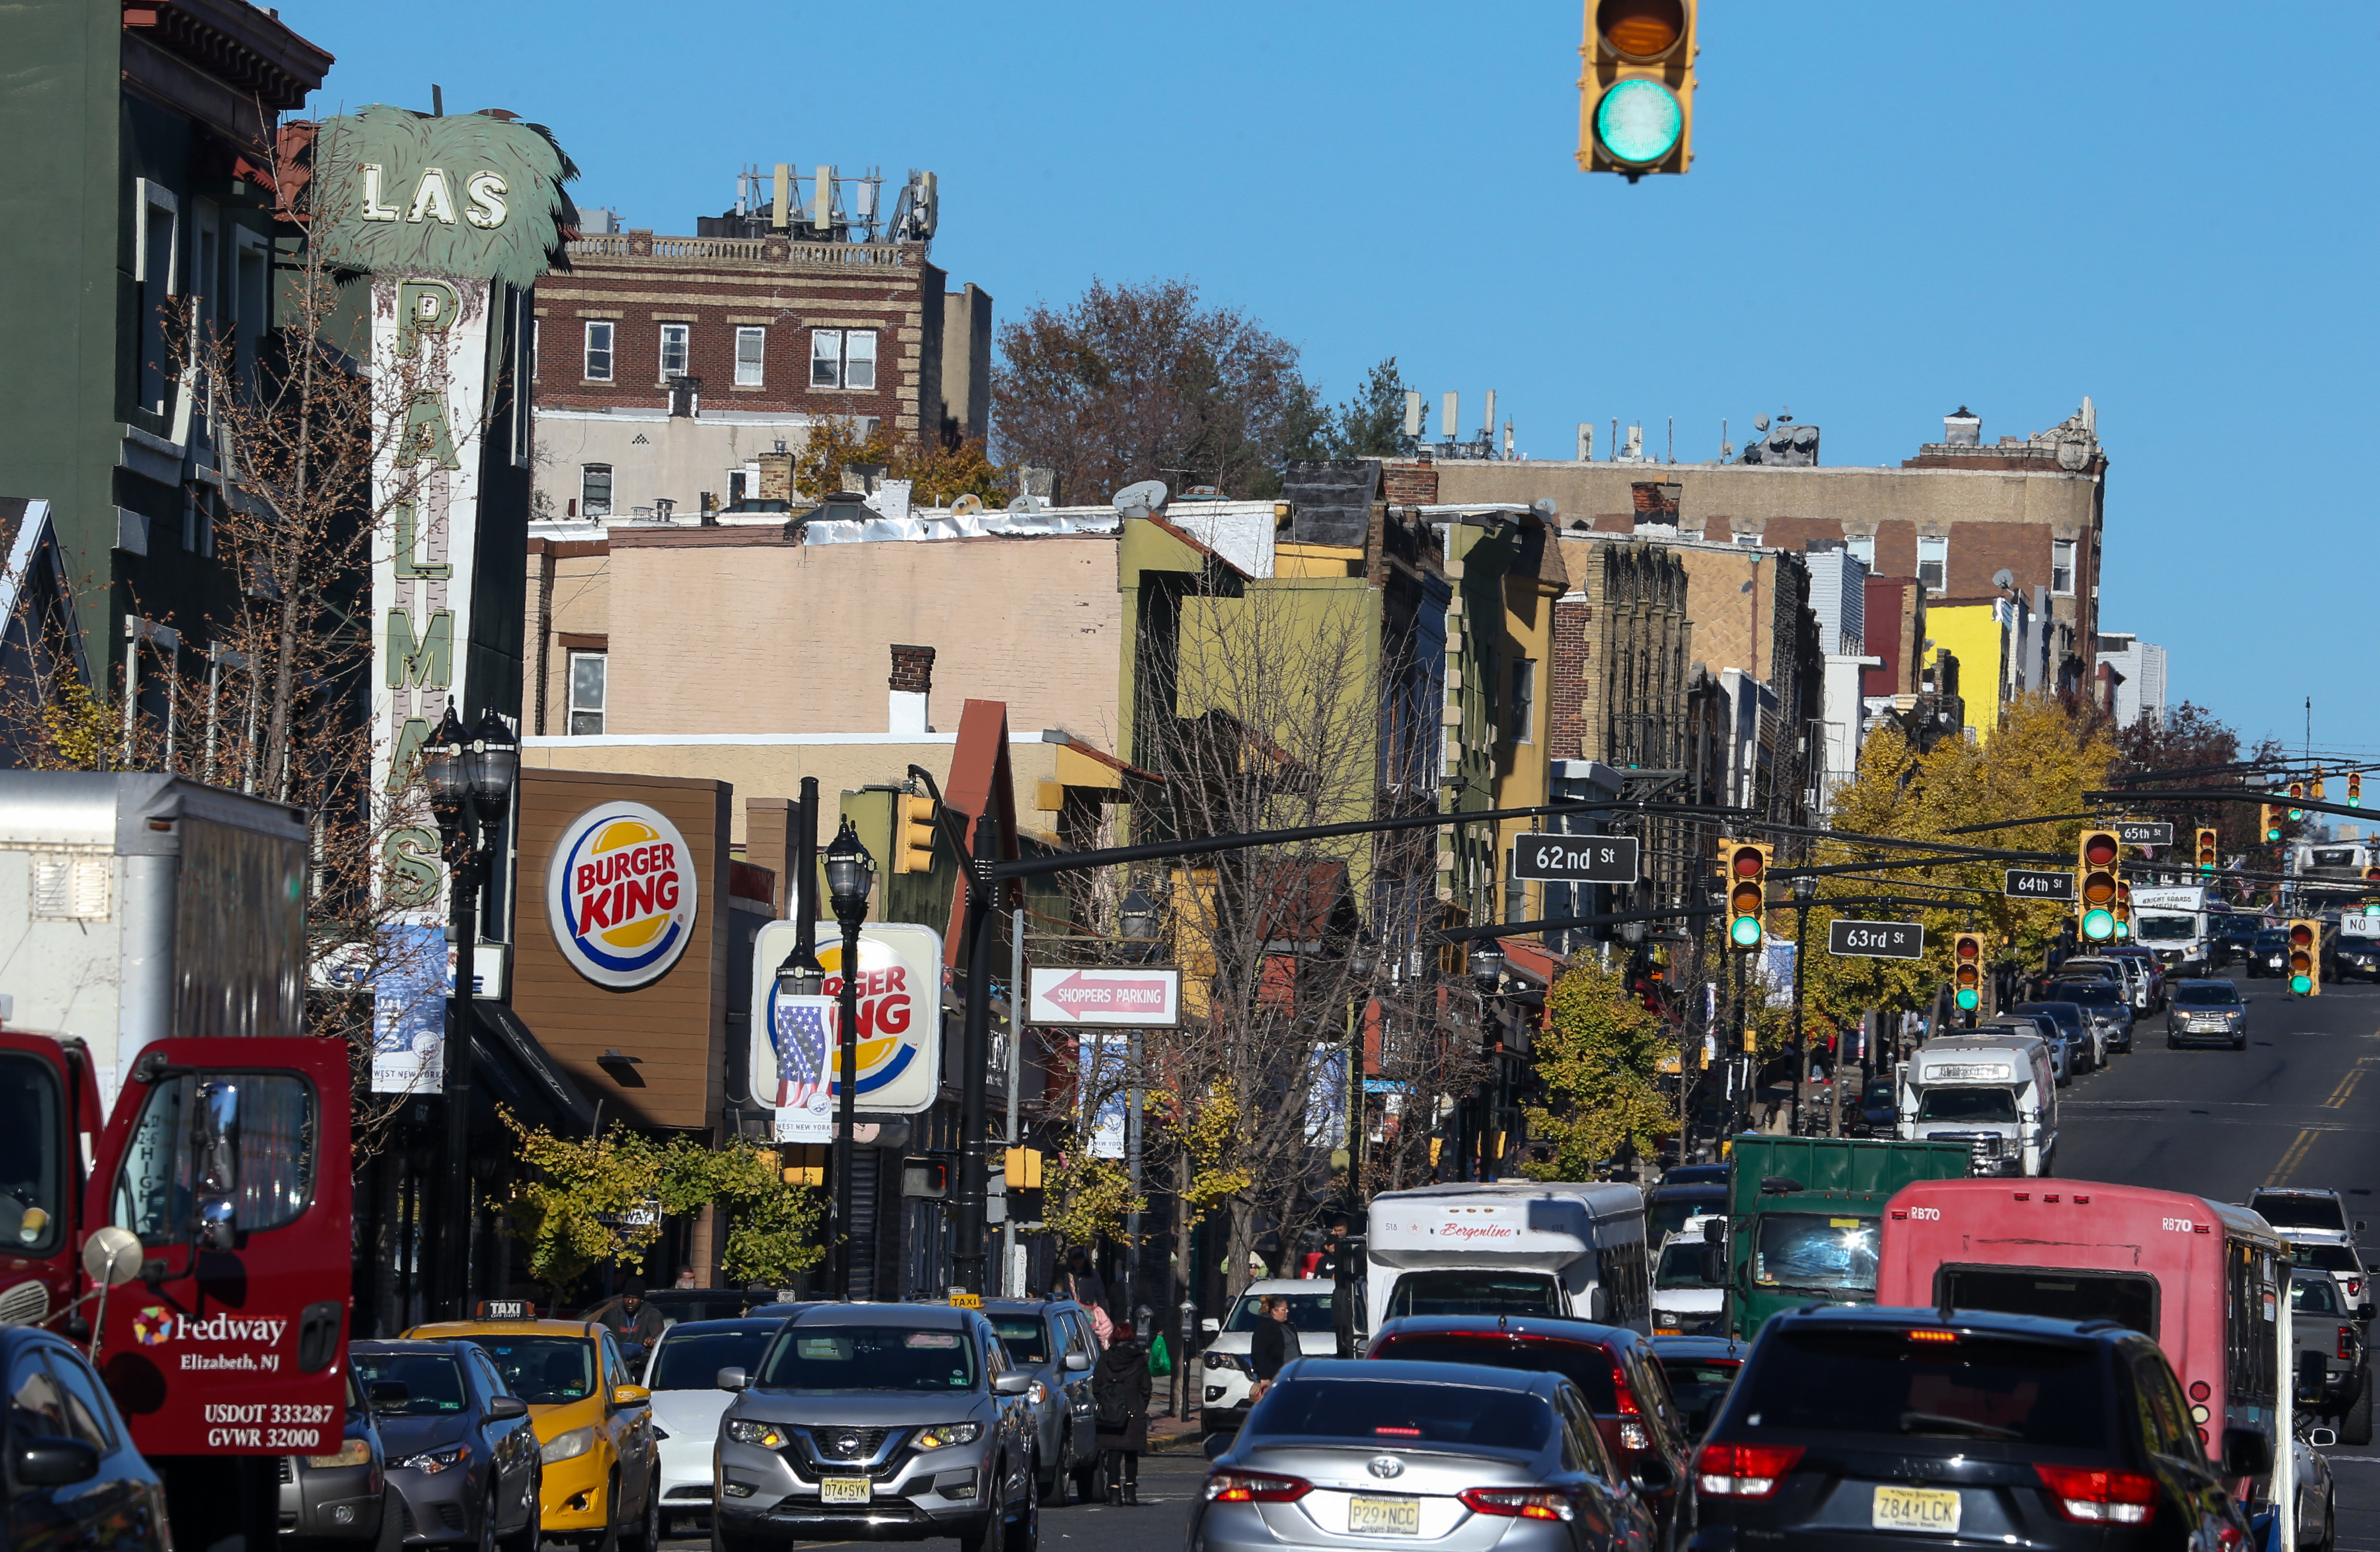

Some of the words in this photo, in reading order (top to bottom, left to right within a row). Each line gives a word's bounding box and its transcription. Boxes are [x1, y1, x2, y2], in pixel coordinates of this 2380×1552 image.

[362, 164, 508, 229] LAS
[382, 279, 460, 906] PALMAS
[2124, 828, 2150, 840] 65th
[2153, 828, 2161, 836] St
[1536, 846, 1590, 869] 62nd
[1600, 848, 1615, 863] St
[577, 843, 675, 895] BURGER
[2018, 876, 2048, 892] 64th
[2053, 878, 2063, 888] St
[575, 871, 679, 938] KING
[2350, 919, 2366, 931] NO
[1847, 929, 1887, 948] 63rd
[1893, 932, 1904, 944] St
[819, 966, 906, 999] RGER
[1057, 988, 1111, 1003] SHOPPERS
[1116, 988, 1162, 1004] PARKING
[626, 1210, 649, 1223] WAY
[1911, 1206, 1940, 1221] RB70
[1439, 1223, 1512, 1241] Bergenline
[2162, 1218, 2192, 1232] RB70
[490, 1302, 521, 1314] TAXI
[952, 1298, 977, 1307] TAXI
[175, 1312, 287, 1347] Fedway
[180, 1353, 257, 1371] Elizabeth,
[260, 1354, 280, 1372] NJ
[204, 1404, 267, 1423] USDOT
[270, 1404, 334, 1424] 333287
[208, 1428, 262, 1447] GVWR
[266, 1428, 320, 1448] 32000
[825, 1484, 843, 1497] D74
[849, 1484, 866, 1497] SYK
[1353, 1505, 1380, 1524] P29
[1389, 1507, 1415, 1525] NCC
[1880, 1497, 1910, 1518] Z84
[1921, 1500, 1953, 1522] LCK
